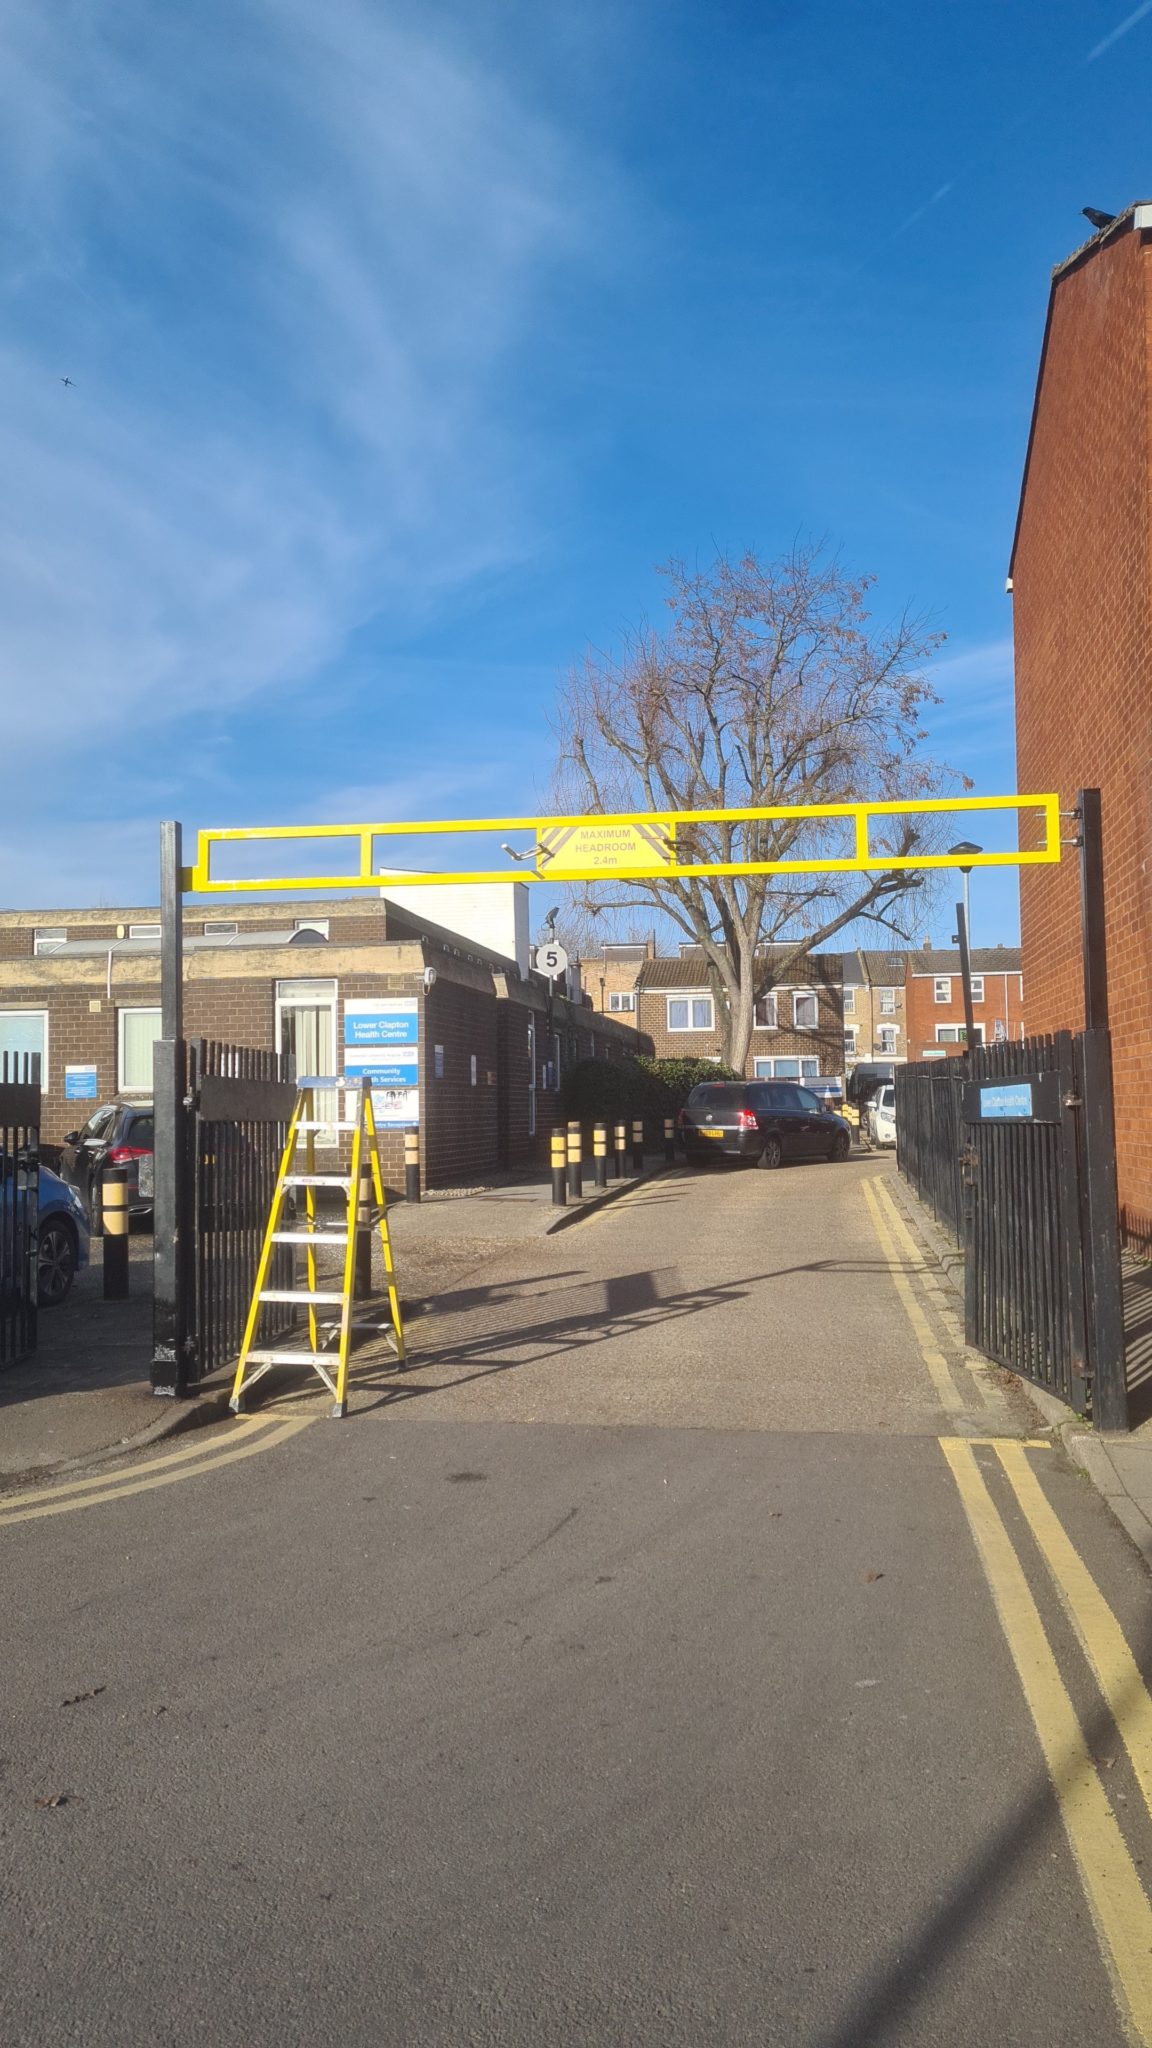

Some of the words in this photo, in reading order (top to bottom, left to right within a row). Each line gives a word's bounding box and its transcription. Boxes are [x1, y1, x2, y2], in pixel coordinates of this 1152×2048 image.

[580, 829, 631, 839] MAXIMUM
[575, 842, 636, 853] HEADROOM
[593, 856, 618, 865] 2.4m
[546, 951, 558, 968] 5
[353, 1021, 377, 1029] Lower
[378, 1020, 409, 1030] Clapton
[354, 1030, 380, 1039] Health
[381, 1030, 408, 1038] Centre
[362, 1068, 401, 1076] Community
